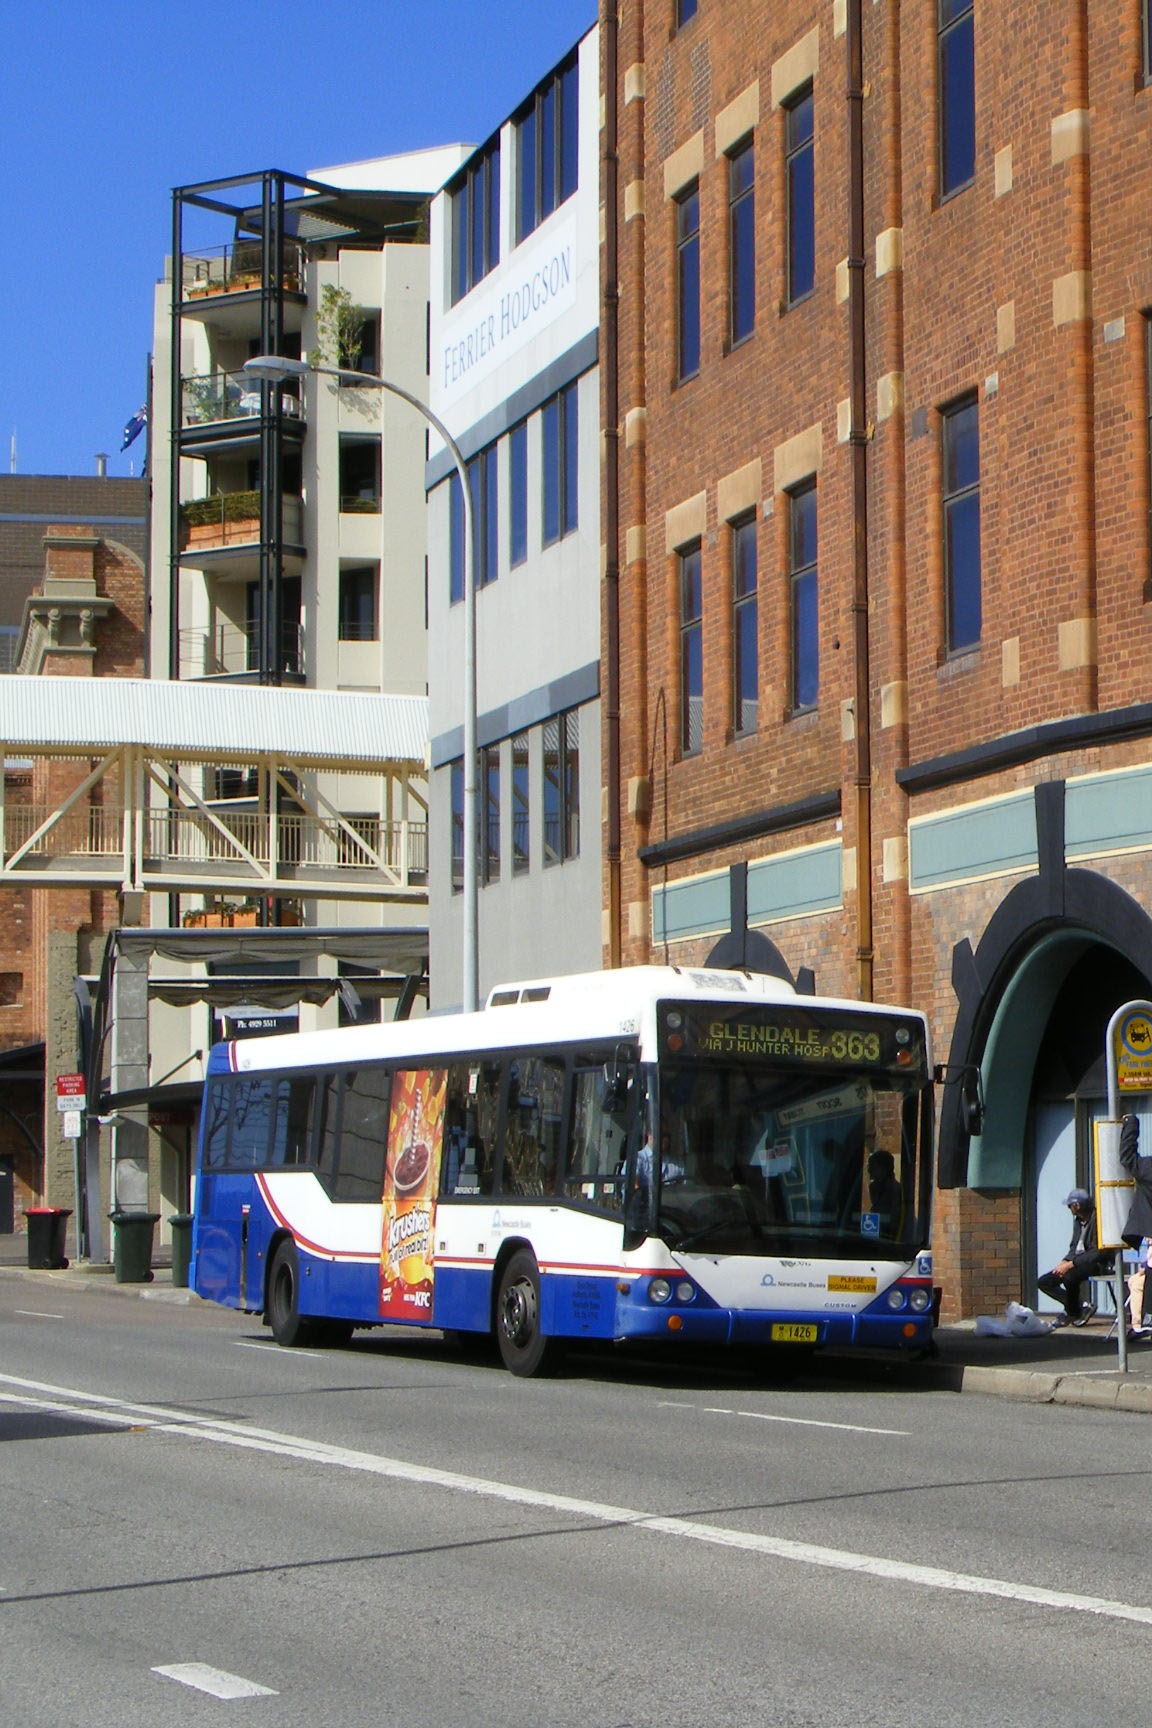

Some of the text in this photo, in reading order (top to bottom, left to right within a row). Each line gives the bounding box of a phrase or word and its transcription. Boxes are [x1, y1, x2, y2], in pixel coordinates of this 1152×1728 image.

[443, 245, 571, 389] FERRIER HODGSON
[709, 1022, 880, 1061] GLENDALE 363
[737, 1040, 791, 1055] HUNTER
[794, 1045, 831, 1057] HOSP
[778, 1280, 807, 1288] Newcastle
[852, 1284, 876, 1292] DRIVER
[414, 1290, 432, 1308] KFC
[789, 1325, 811, 1338] 1426
